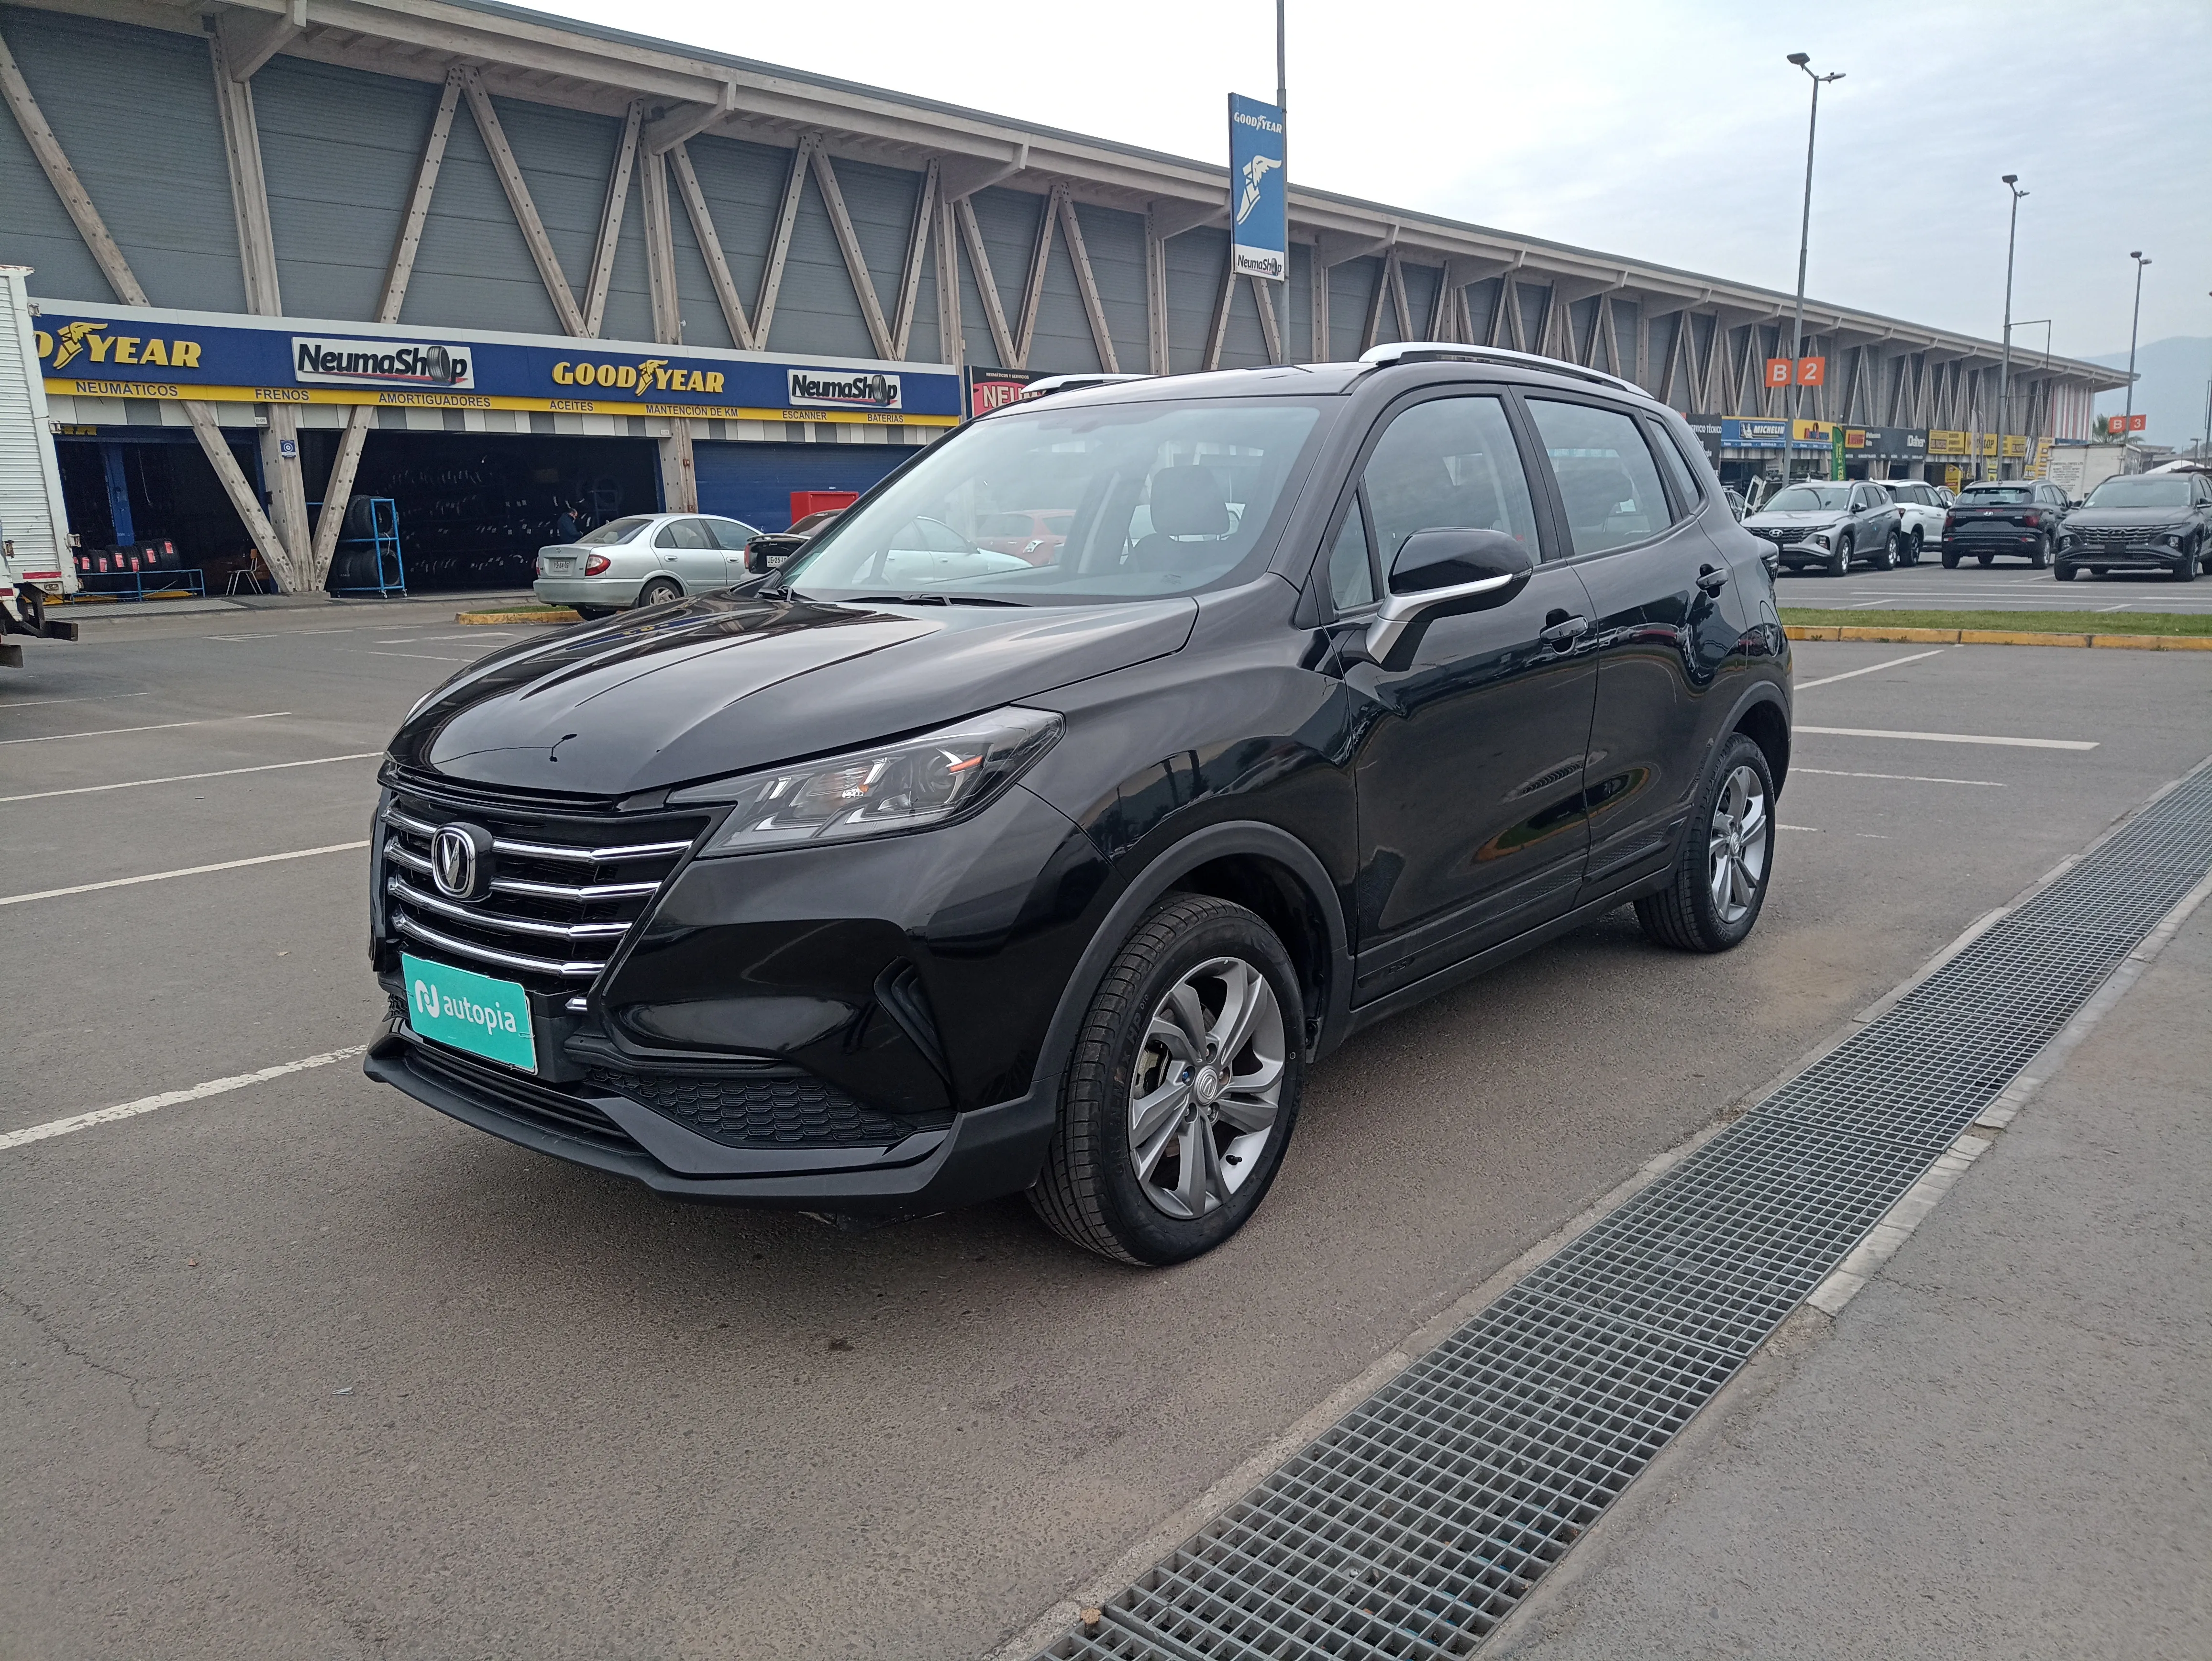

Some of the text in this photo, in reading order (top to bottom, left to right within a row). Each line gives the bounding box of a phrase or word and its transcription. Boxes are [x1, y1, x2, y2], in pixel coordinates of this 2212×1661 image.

[1234, 112, 1282, 133] GOODYEAR
[552, 361, 724, 394] GOODYEAR
[1773, 363, 1817, 381] B 2
[76, 381, 178, 397] NEUMÁTICOS
[255, 389, 309, 401] FRENOS
[379, 393, 490, 407] AMORTIGUADORES
[550, 400, 593, 411] ACEITES
[646, 405, 738, 417] MANTENCIÓN DE KM
[783, 410, 827, 420] ESCANNER
[867, 413, 903, 422] BATERIAS
[1706, 423, 1722, 433] TÉCNICO
[1753, 425, 1785, 434] MICHELIN
[2113, 419, 2141, 429] B 3
[443, 996, 517, 1035] autopia
